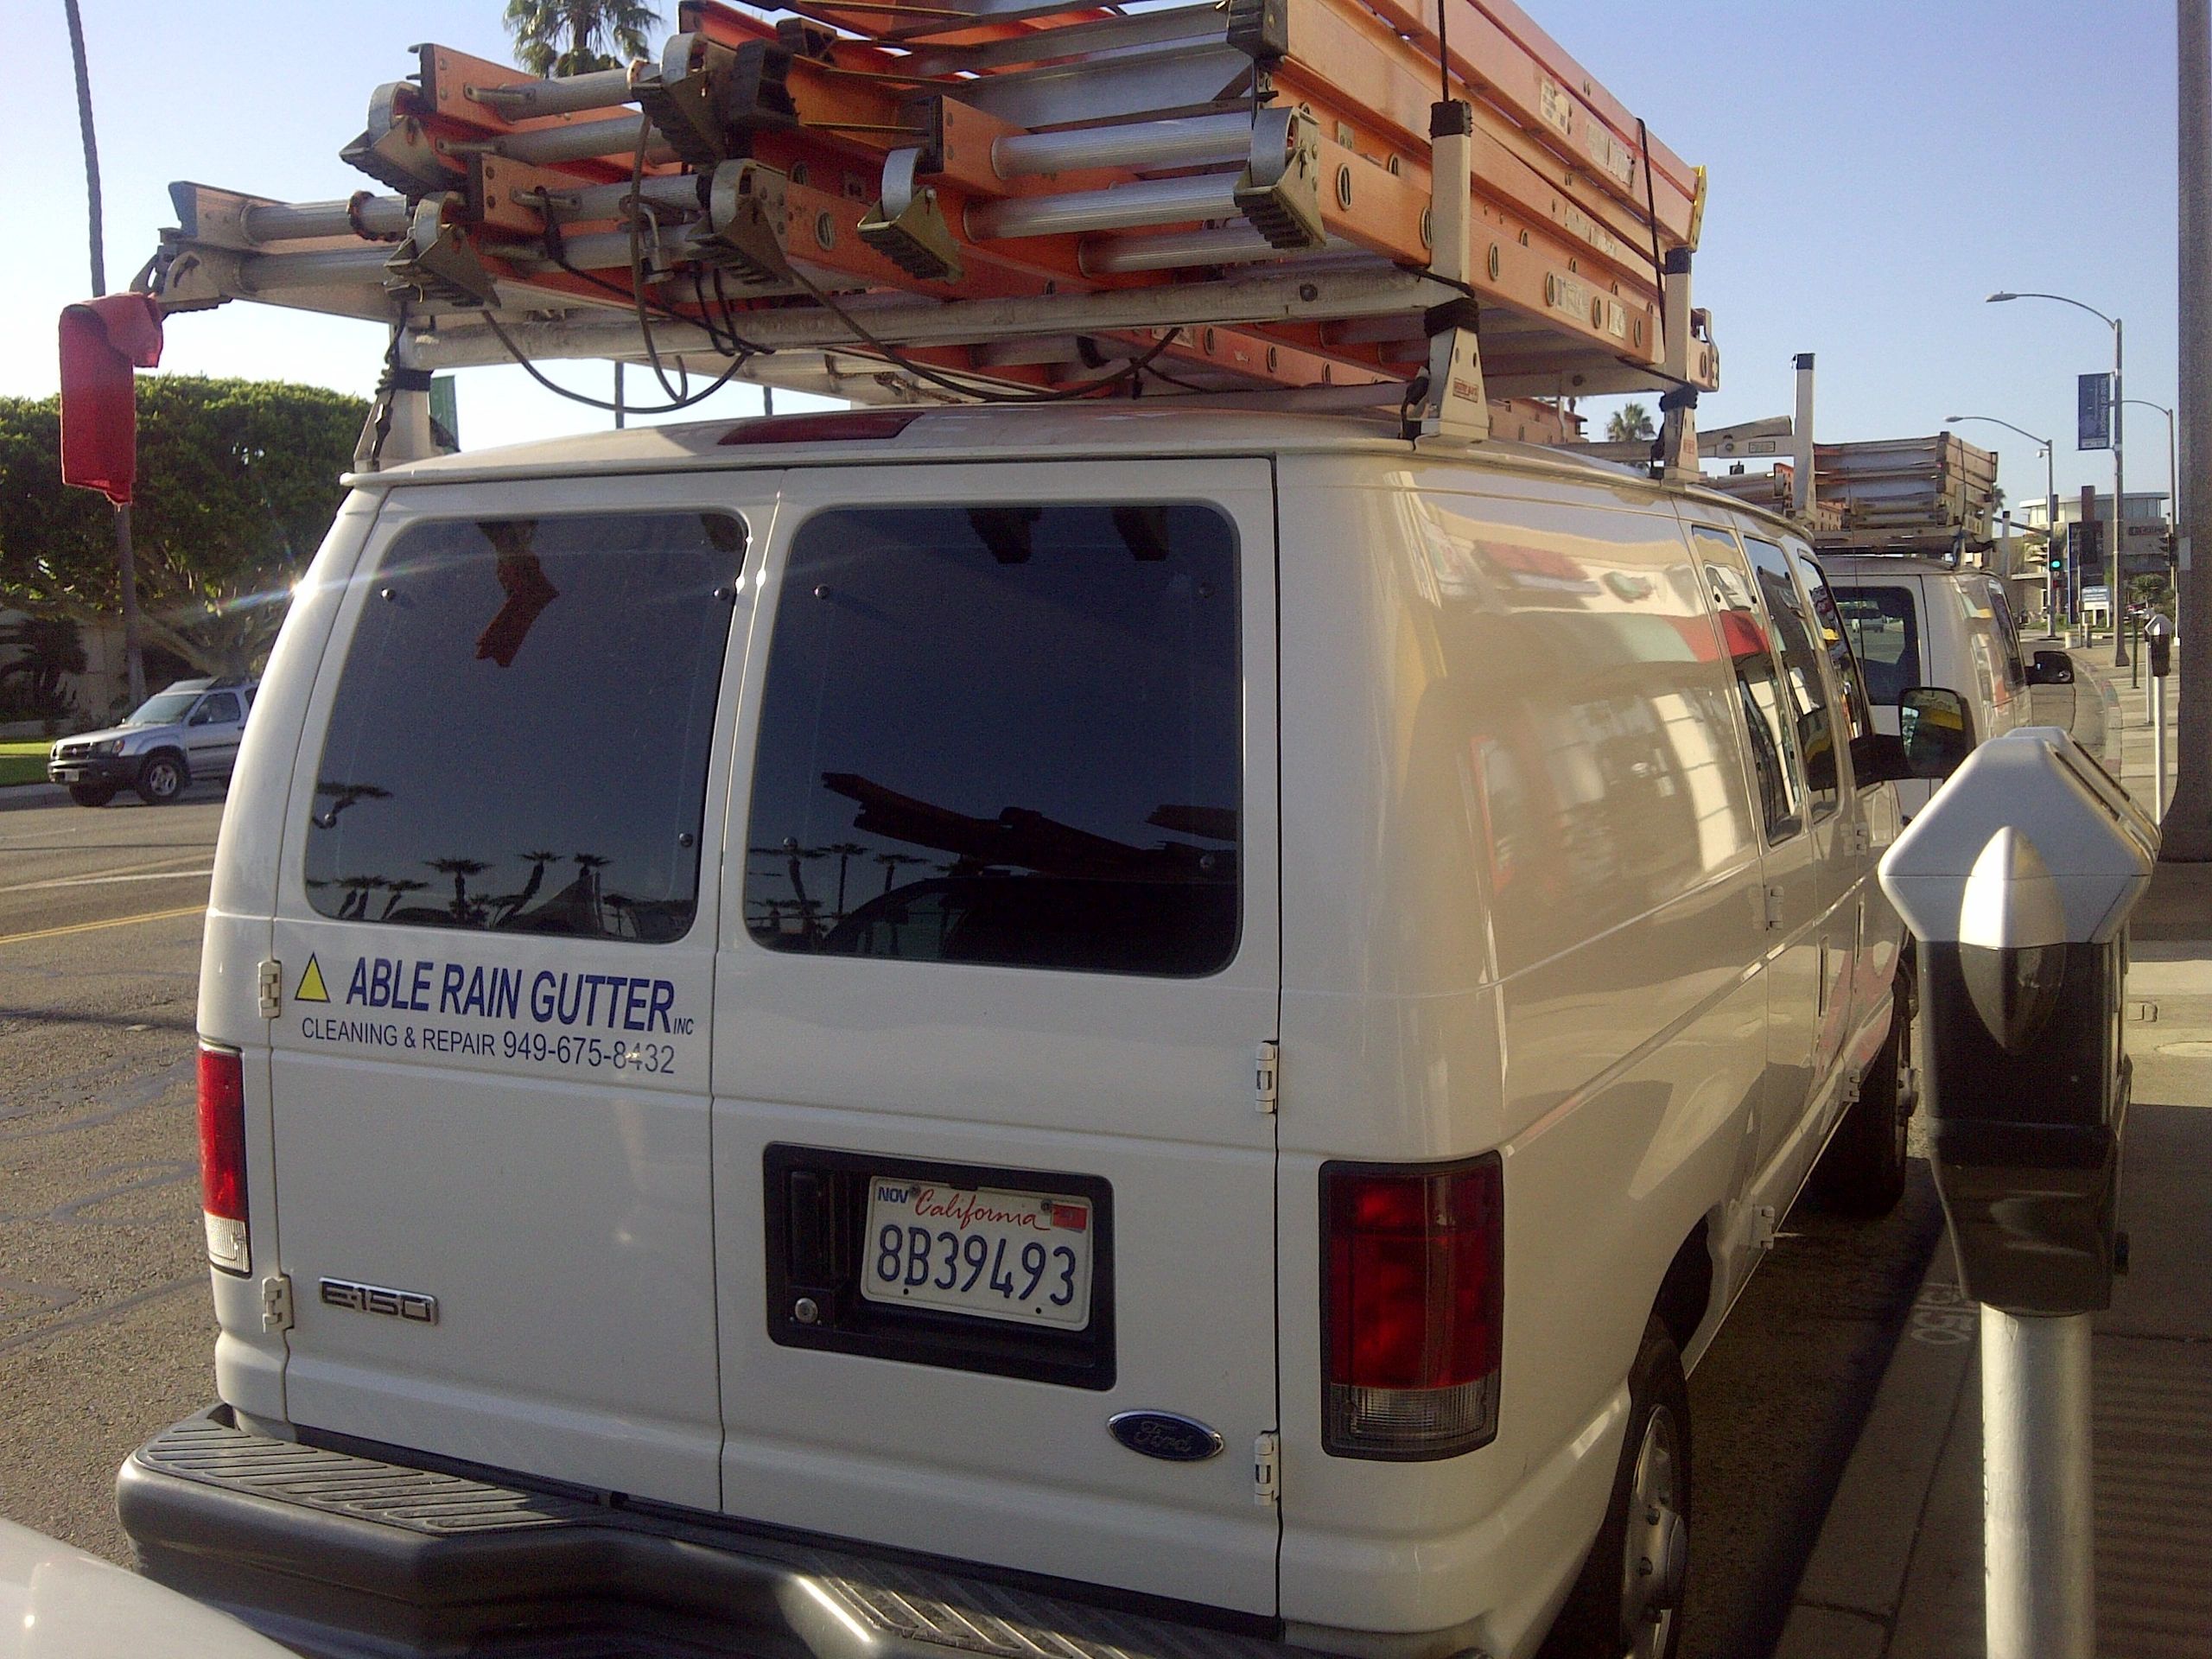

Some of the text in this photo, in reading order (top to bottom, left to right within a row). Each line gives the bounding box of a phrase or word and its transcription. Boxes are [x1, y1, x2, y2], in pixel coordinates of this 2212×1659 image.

[346, 957, 695, 1035] ABLE RAIN GUTTER INC
[302, 1017, 675, 1074] CLEANING & REPAIR 949-675-8432
[877, 1186, 909, 1204] NOV
[914, 1188, 1051, 1230] California
[878, 1224, 1076, 1305] 8B39493
